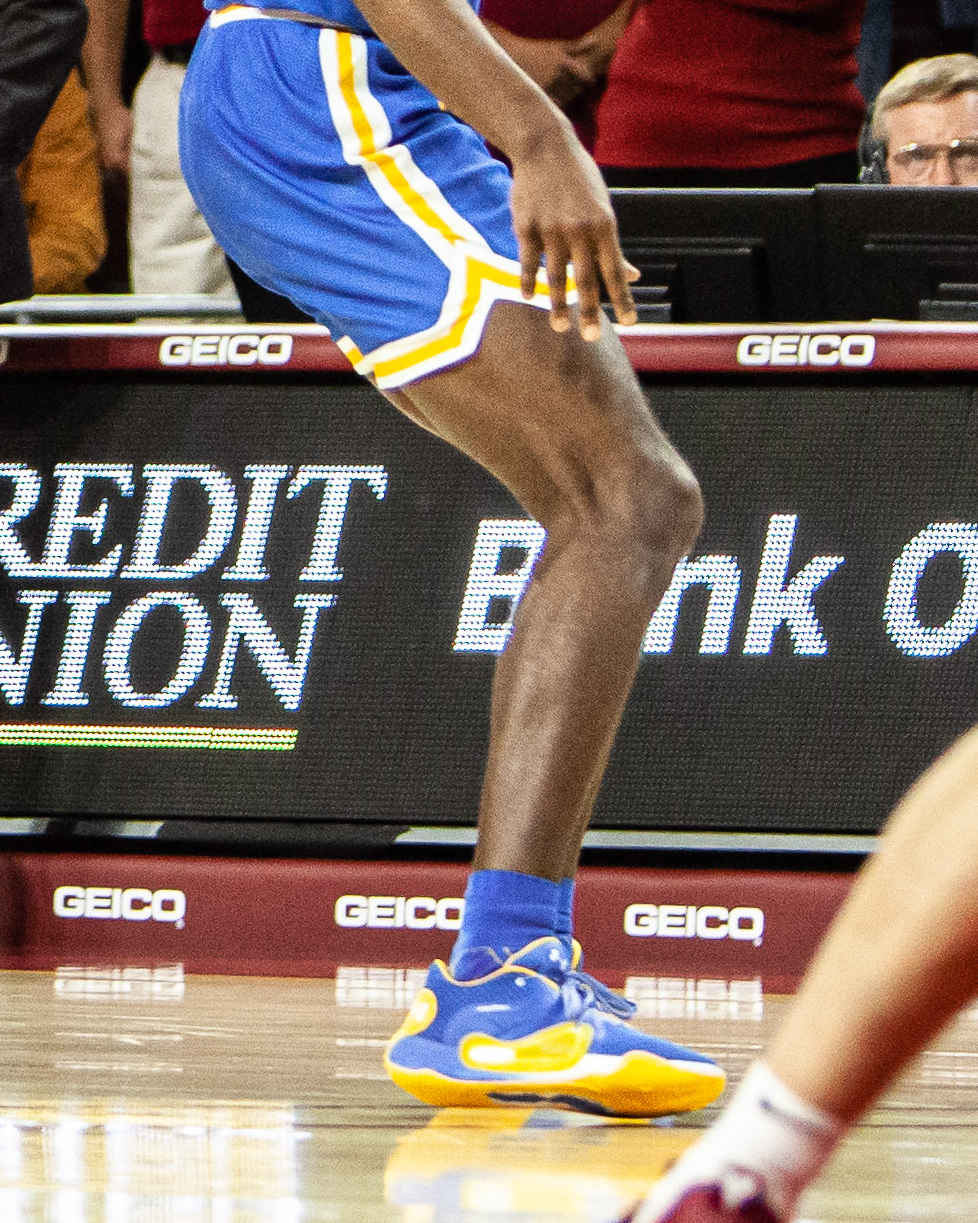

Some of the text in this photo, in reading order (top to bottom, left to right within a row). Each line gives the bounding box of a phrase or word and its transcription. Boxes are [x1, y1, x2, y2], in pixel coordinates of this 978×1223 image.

[159, 335, 293, 366] GEICO
[737, 334, 876, 366] GEICO
[453, 513, 845, 655] Bnk
[53, 885, 187, 923] GEICO
[624, 903, 765, 940] GEICO
